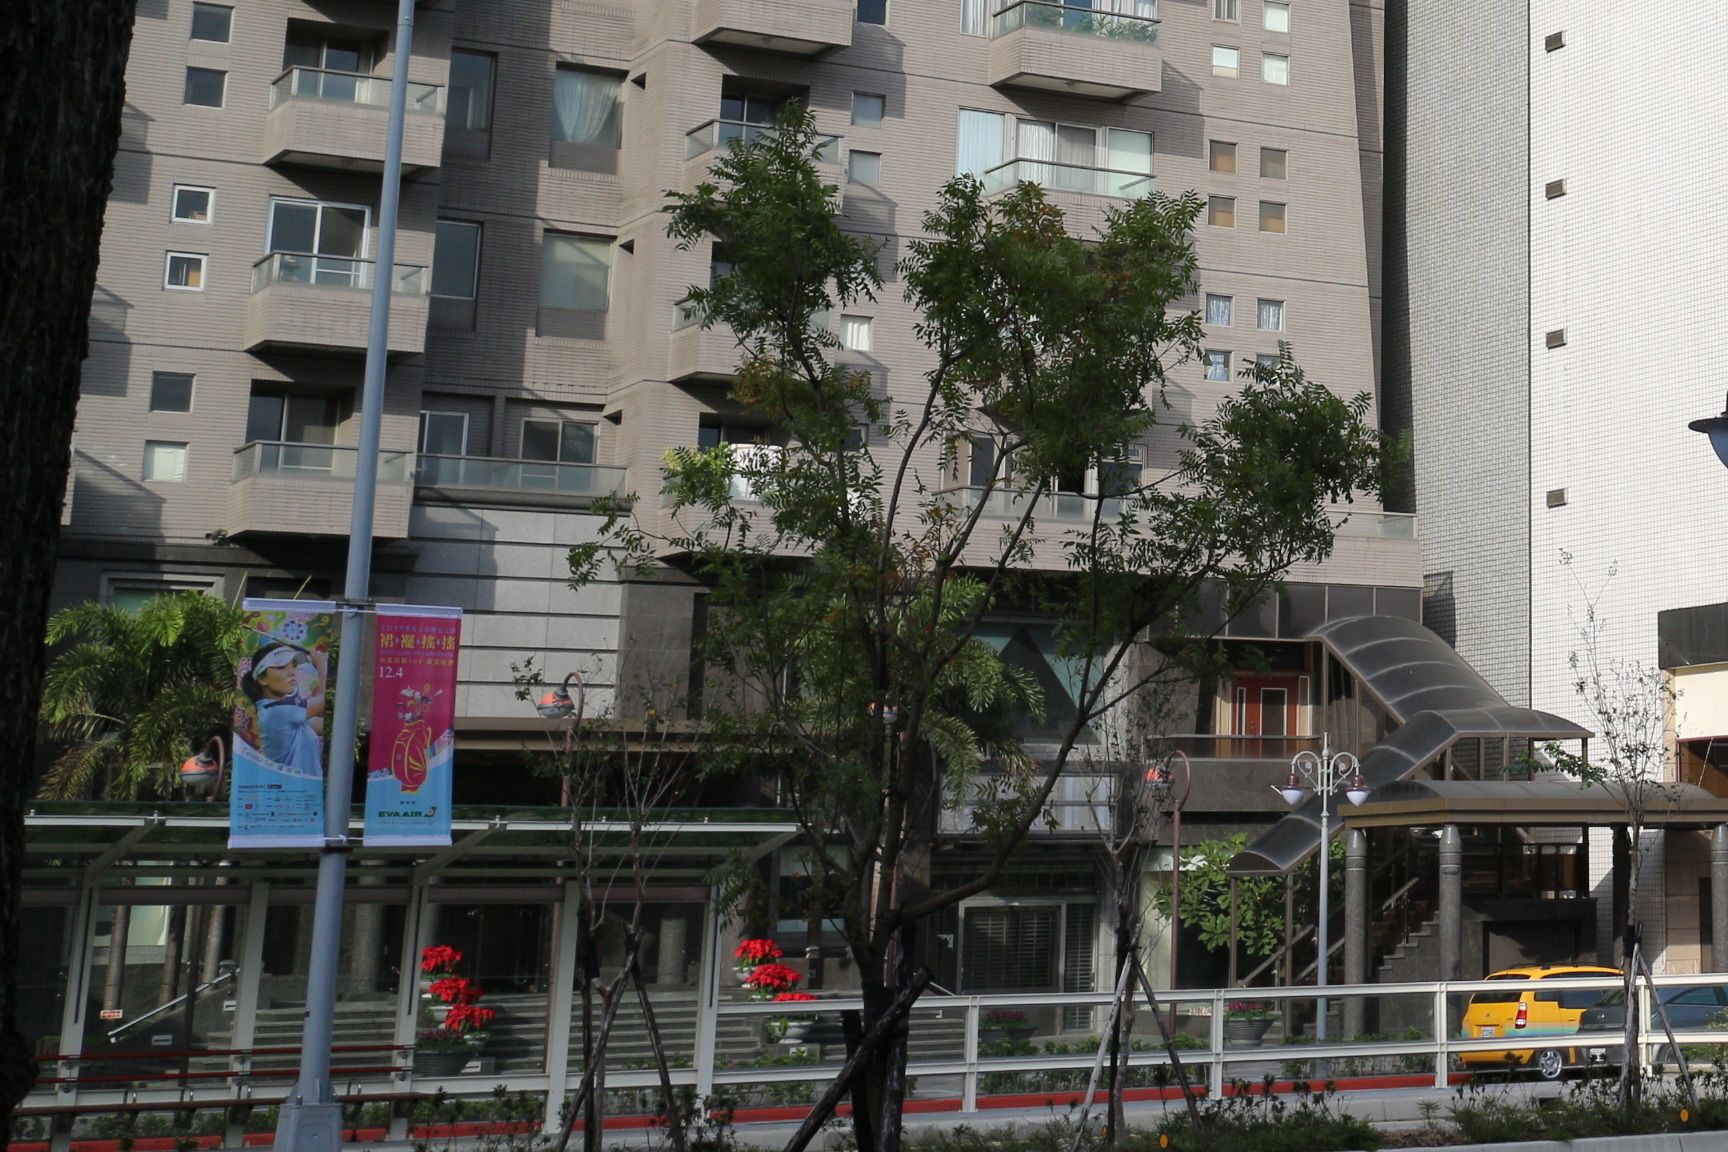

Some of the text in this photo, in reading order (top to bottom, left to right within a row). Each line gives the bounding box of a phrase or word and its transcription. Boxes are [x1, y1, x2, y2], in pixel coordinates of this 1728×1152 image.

[379, 665, 404, 679] 12.4
[378, 810, 422, 818] EVA AIR
